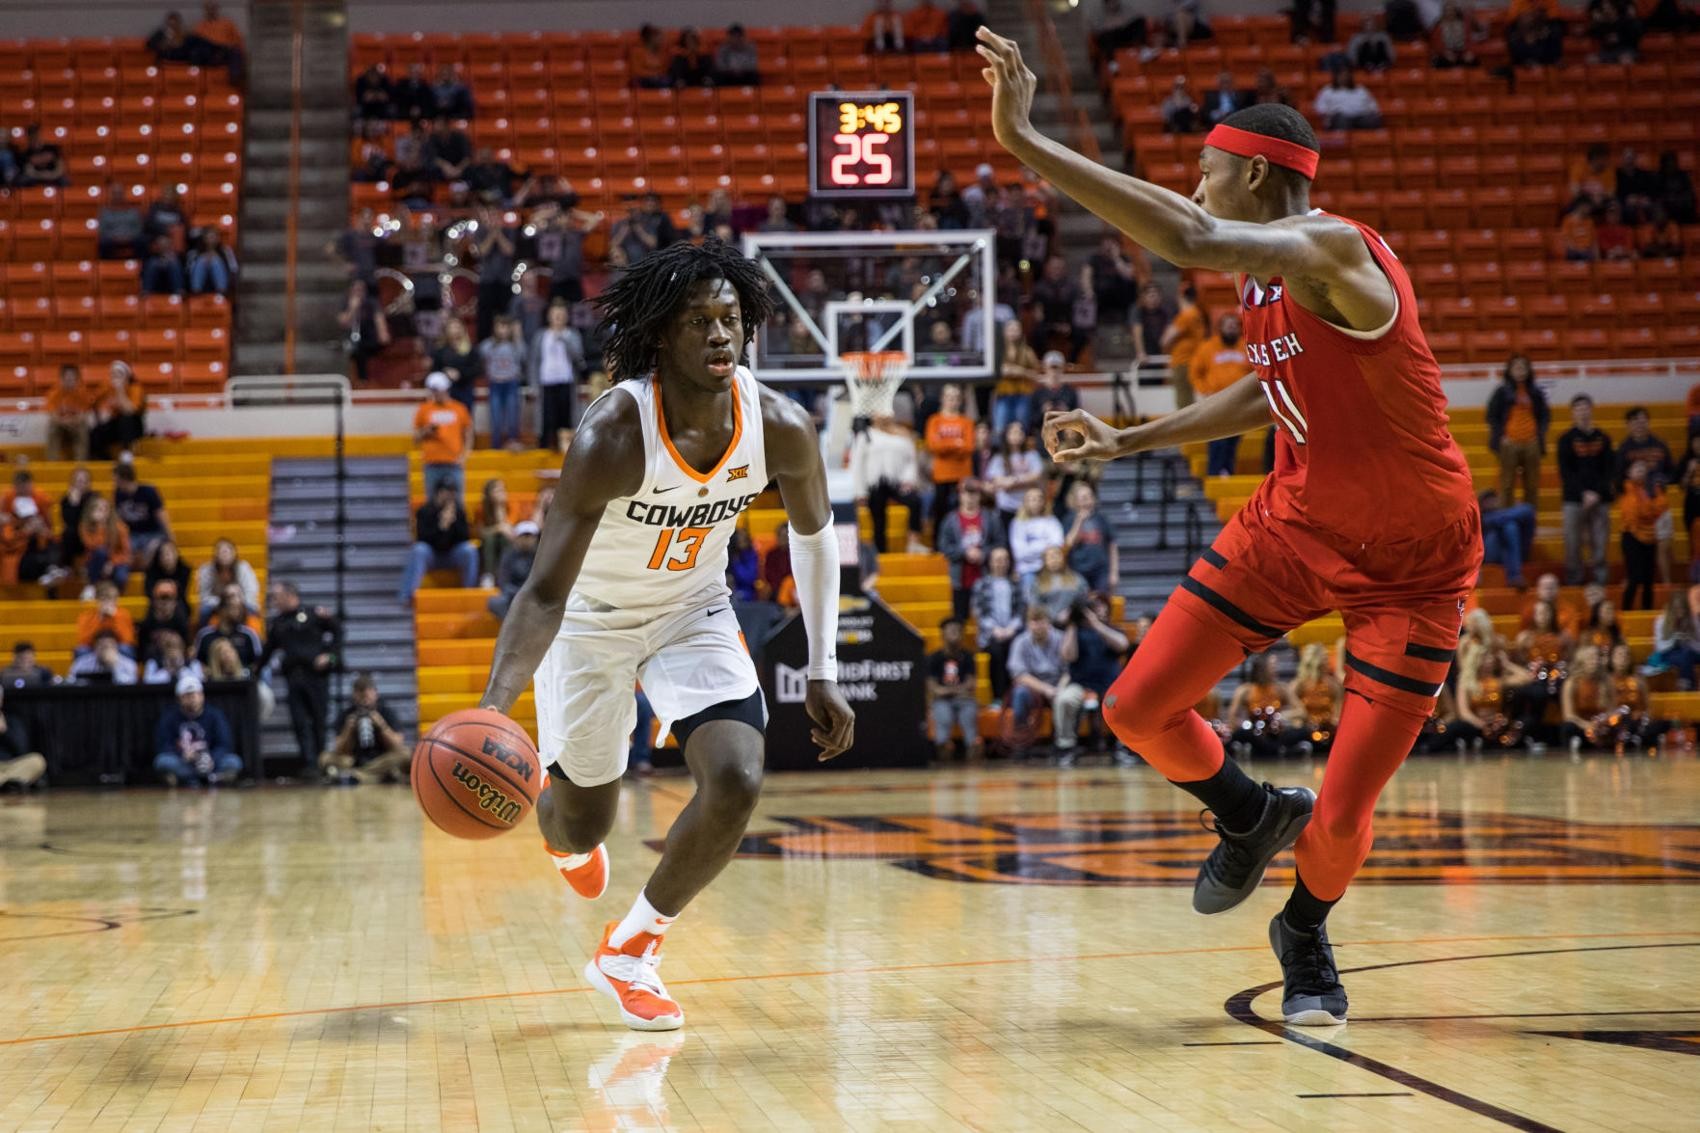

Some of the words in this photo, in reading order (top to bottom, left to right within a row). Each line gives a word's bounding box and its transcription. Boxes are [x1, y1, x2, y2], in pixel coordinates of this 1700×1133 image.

[840, 103, 901, 133] 3:45
[831, 133, 892, 184] 25
[1259, 379, 1308, 444] 11
[626, 491, 760, 527] COWBOYS
[646, 526, 716, 572] 13
[838, 682, 878, 701] ANK
[482, 736, 535, 783] NCAA
[451, 760, 523, 825] Wilson
